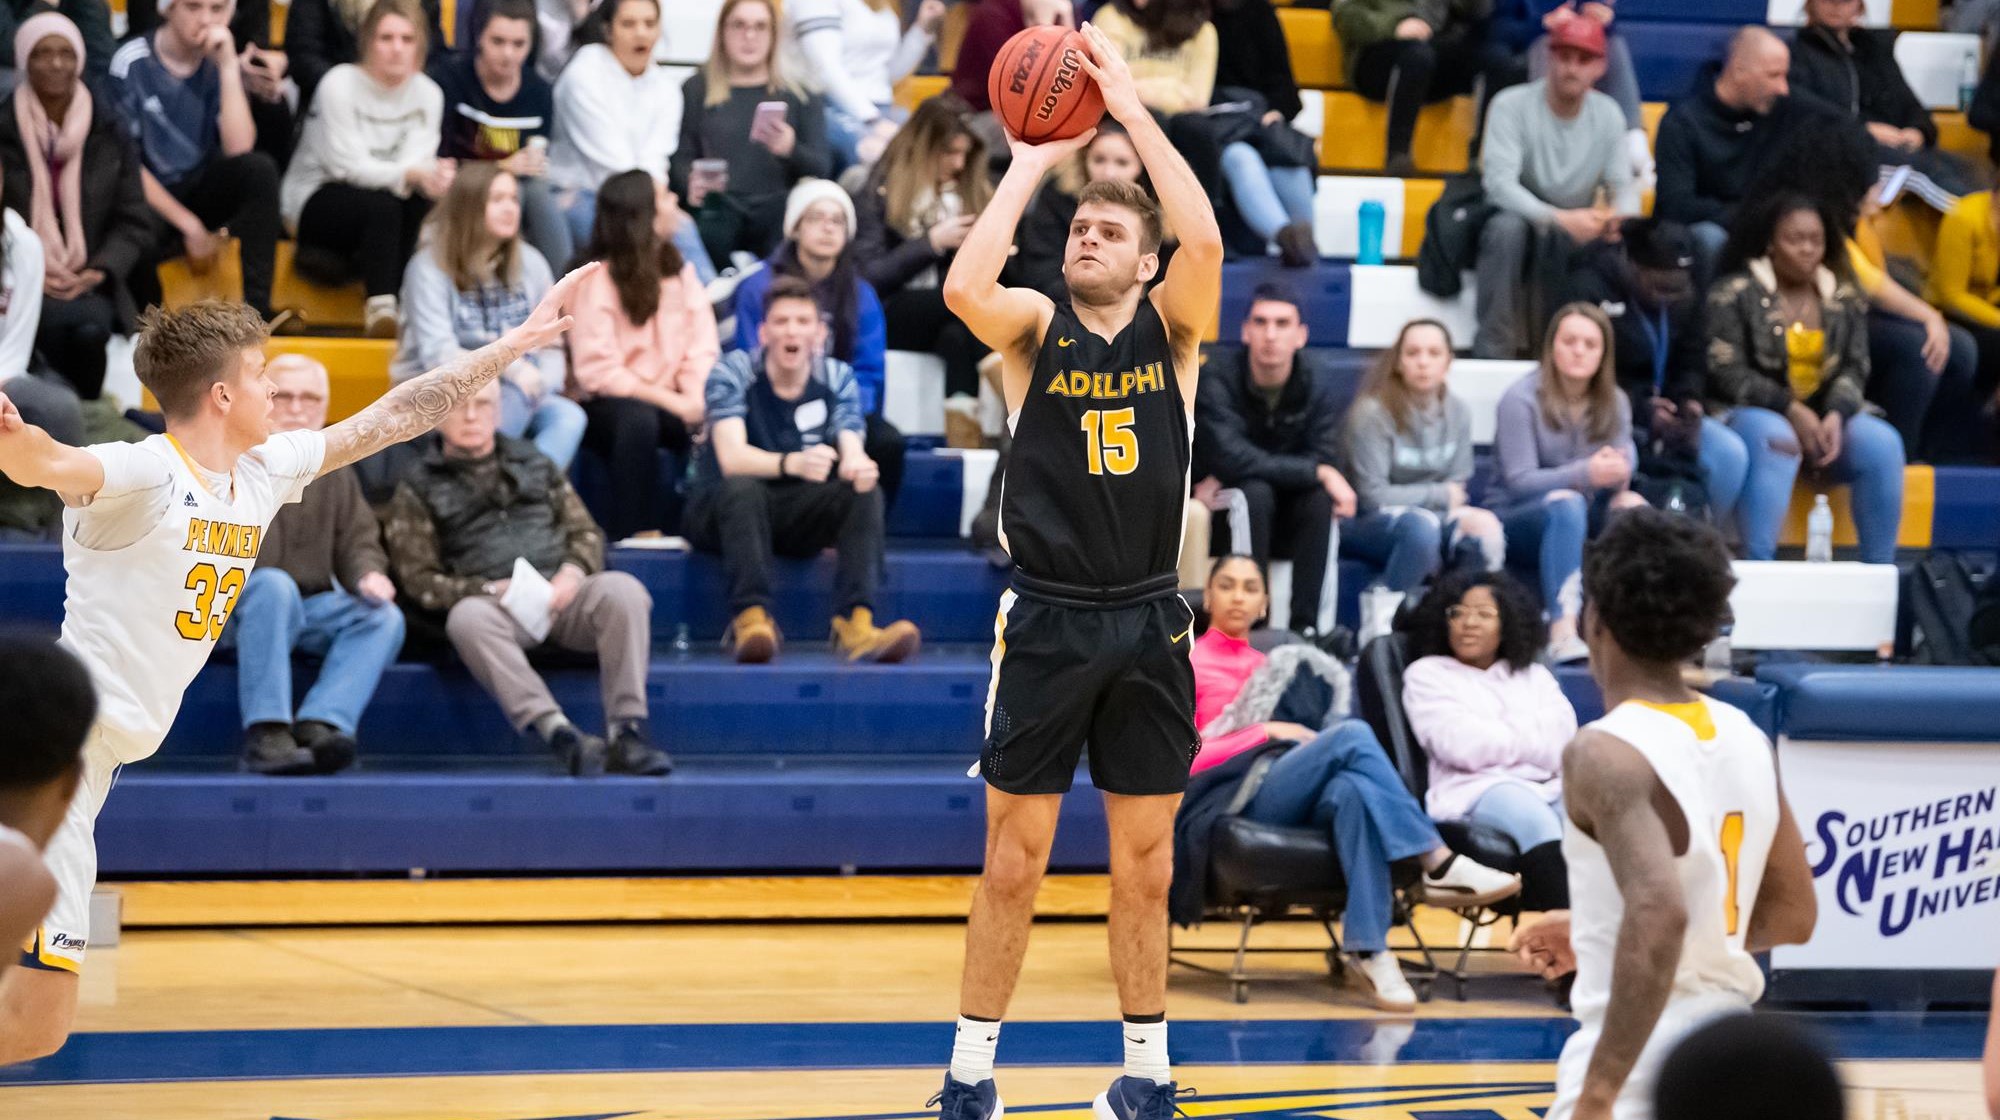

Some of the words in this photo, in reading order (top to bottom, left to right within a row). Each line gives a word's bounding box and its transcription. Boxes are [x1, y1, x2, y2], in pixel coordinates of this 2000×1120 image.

[1036, 48, 1081, 121] Wilson
[1046, 361, 1165, 399] ADELPHI
[1081, 407, 1139, 475] 15
[182, 517, 261, 559] PENMEN
[174, 562, 246, 641] 33
[1804, 787, 1996, 878] SOUTHERN
[1719, 811, 1744, 936] 1
[1837, 846, 1928, 917] NEW
[1933, 827, 2000, 880] HA
